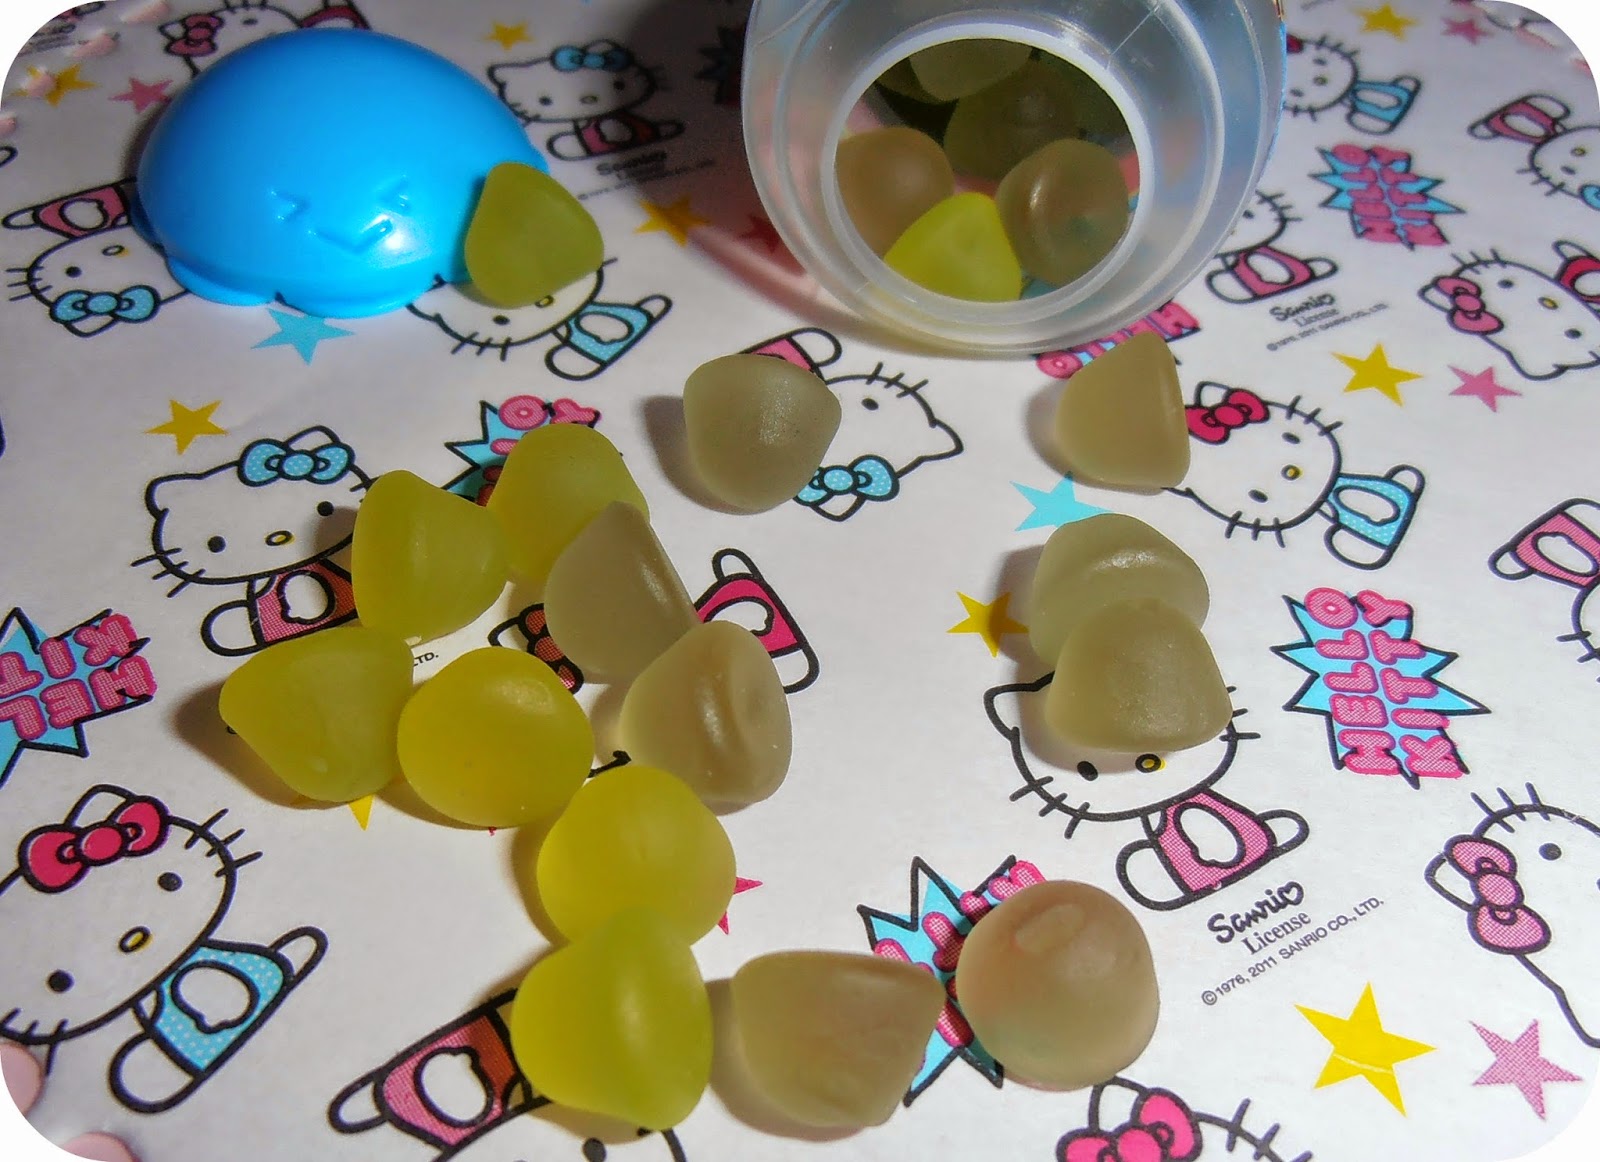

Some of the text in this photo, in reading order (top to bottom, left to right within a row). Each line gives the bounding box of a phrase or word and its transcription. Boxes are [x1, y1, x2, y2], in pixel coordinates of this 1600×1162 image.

[0, 613, 138, 699] KIT
[0, 655, 158, 741] HEL
[1304, 587, 1402, 776] HELLO
[1356, 589, 1463, 779] KITTY
[1206, 880, 1305, 944] Sanrio
[1240, 911, 1312, 955] License
[1248, 956, 1278, 978] 2011
[1278, 926, 1328, 960] SANRIO
[1353, 896, 1385, 917] LTD.
